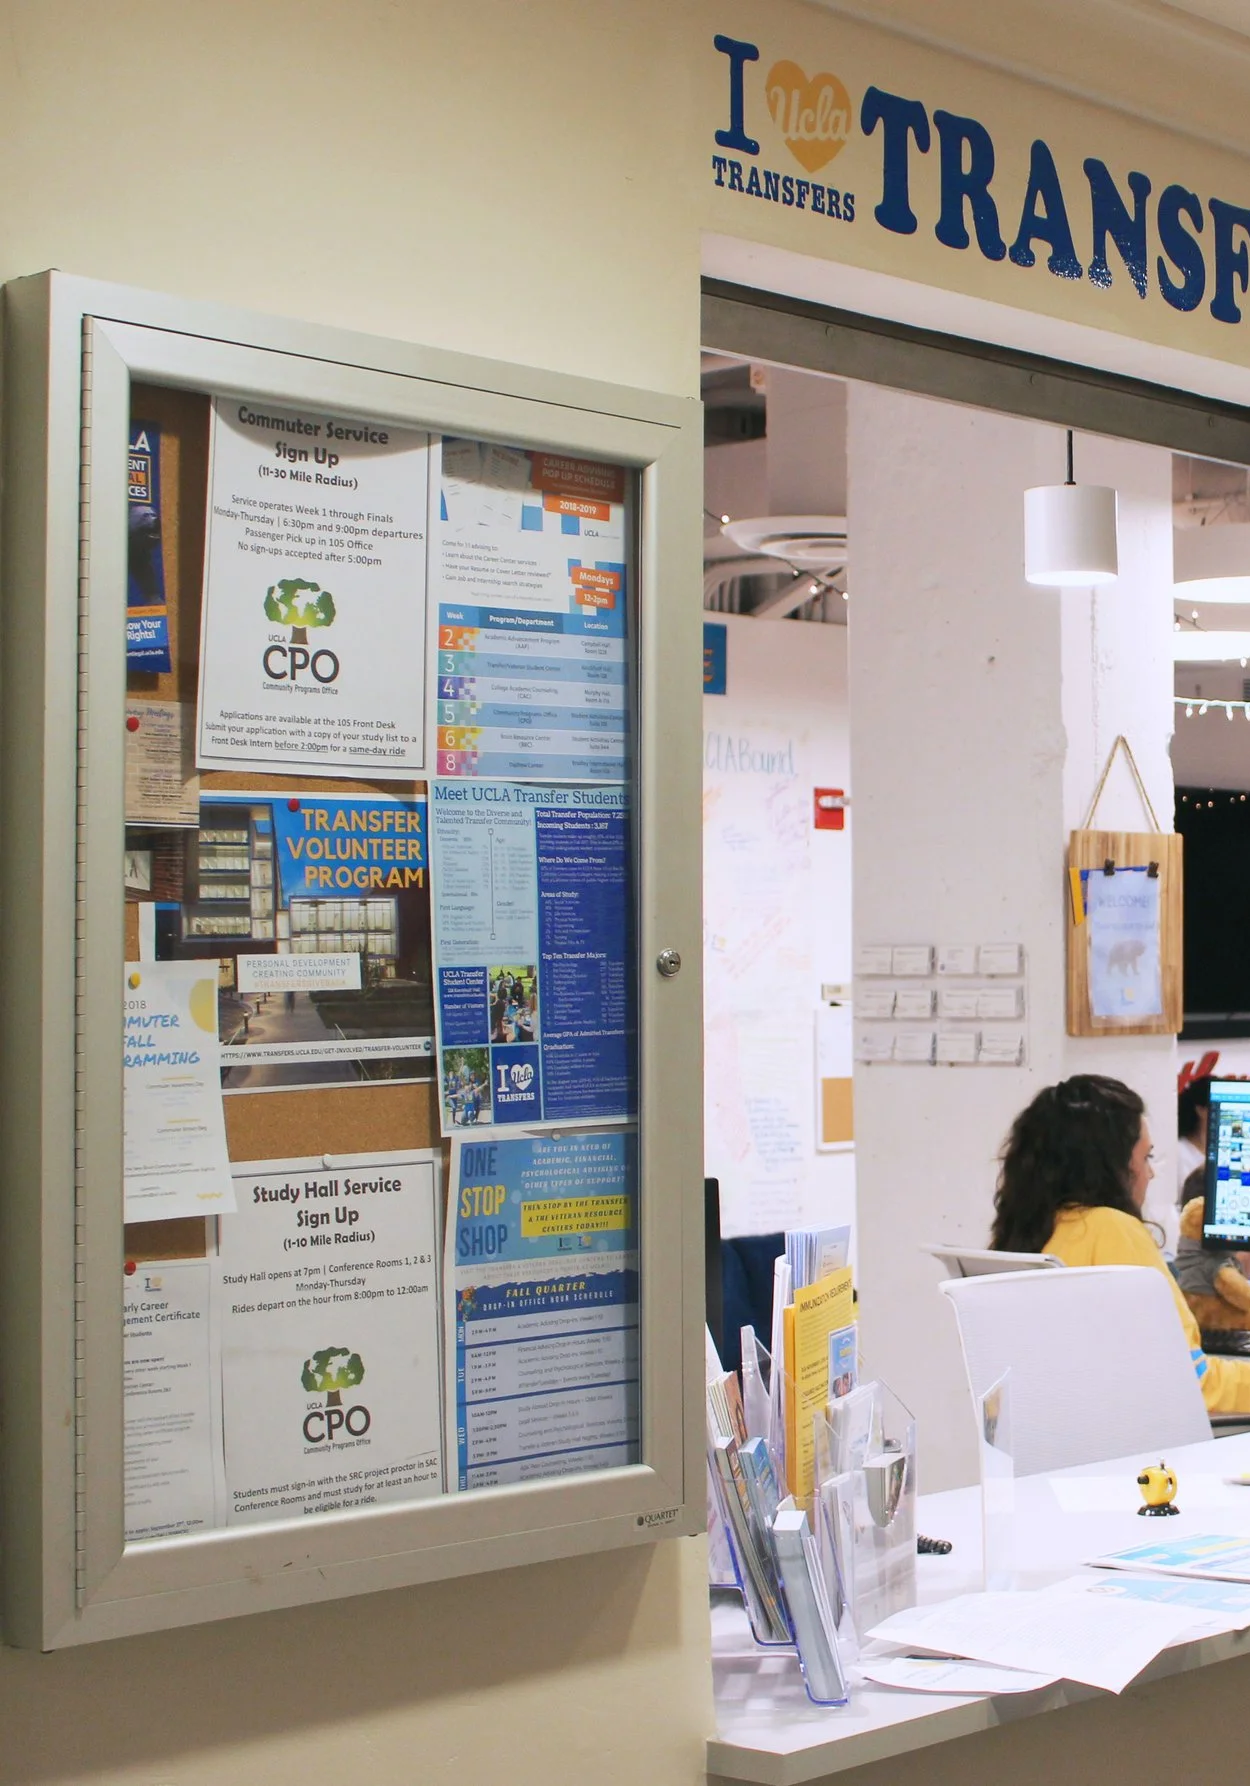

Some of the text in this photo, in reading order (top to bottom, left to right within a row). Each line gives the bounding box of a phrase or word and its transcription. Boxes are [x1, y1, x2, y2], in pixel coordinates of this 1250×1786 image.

[713, 34, 760, 156] I
[770, 84, 851, 142] Ucla
[712, 154, 856, 224] TRANSFERS
[237, 406, 388, 444] Commuter Service
[275, 441, 340, 468] Sign Up
[258, 465, 358, 489] (11-30 Mile Radius)
[231, 494, 393, 523] Service operates Week 1 through Finals
[560, 500, 597, 515] 2018-2019
[213, 506, 423, 539] Monday-Thursday 6:30pm and 9:00pm departures
[245, 527, 373, 550] Passenger Pick up in 105 Office
[584, 529, 599, 537] UCLA
[237, 541, 381, 566] No sign-ups accepted after 5:00pm
[580, 572, 614, 586] Mondays
[141, 620, 161, 629] Your
[446, 611, 608, 630] Week Program/Department Location
[268, 634, 287, 642] UCLA
[444, 629, 454, 647] 2
[263, 644, 340, 683] CPO
[445, 655, 454, 672] 3
[262, 681, 338, 694] Community Programs Office
[444, 679, 455, 696] 4
[219, 710, 263, 720] Applications
[278, 715, 311, 724] available
[322, 717, 335, 725] the
[337, 718, 350, 726] 105
[352, 719, 374, 728] Front
[375, 720, 395, 728] Desk
[445, 704, 455, 723] 5
[445, 731, 456, 746] 6
[446, 754, 456, 771] 8
[435, 786, 629, 805] Meet UCLA Transfer Students
[301, 808, 422, 833] TRANSFER
[286, 837, 423, 860] VOLUNTEER
[304, 866, 424, 888] PROGRAM
[246, 958, 350, 968] PERSONAL DEVELOPMENT
[251, 968, 346, 977] CREATING COMMUNITY
[496, 1065, 509, 1092] I
[497, 1092, 535, 1102] TRANSFERS
[463, 1147, 498, 1178] ONE
[253, 1177, 401, 1202] Study Hall Service
[460, 1184, 506, 1218] STOP
[296, 1206, 359, 1228] Sign Up
[283, 1230, 375, 1251] (1-10 Mile Radius)
[460, 1224, 508, 1258] SHOP
[222, 1254, 431, 1284] Study Hall opens at 7pm Conference Rooms 1, 2 & 3
[295, 1277, 366, 1290] Monday-Thursday
[506, 1281, 585, 1297] FALL QUARTER
[140, 1302, 168, 1311] Career
[231, 1304, 255, 1313] Rides
[256, 1301, 284, 1311] depart
[297, 1297, 311, 1306] the
[332, 1293, 352, 1302] from
[353, 1290, 384, 1299] 8:00pm
[396, 1285, 428, 1294] 12:00am
[155, 1311, 200, 1322] Certificate
[306, 1402, 323, 1410] UCLA
[303, 1405, 371, 1443] CPO
[303, 1444, 331, 1454] Community
[332, 1441, 355, 1450] Programs
[233, 1488, 268, 1499] Students
[270, 1484, 289, 1493] must
[290, 1480, 315, 1490] sign-in
[316, 1476, 333, 1485] with
[335, 1474, 347, 1482] the
[348, 1470, 363, 1480] SRC
[364, 1467, 389, 1479] project
[390, 1463, 416, 1474] proctor
[425, 1457, 437, 1467] SAC
[645, 1509, 676, 1524] QUARTET
